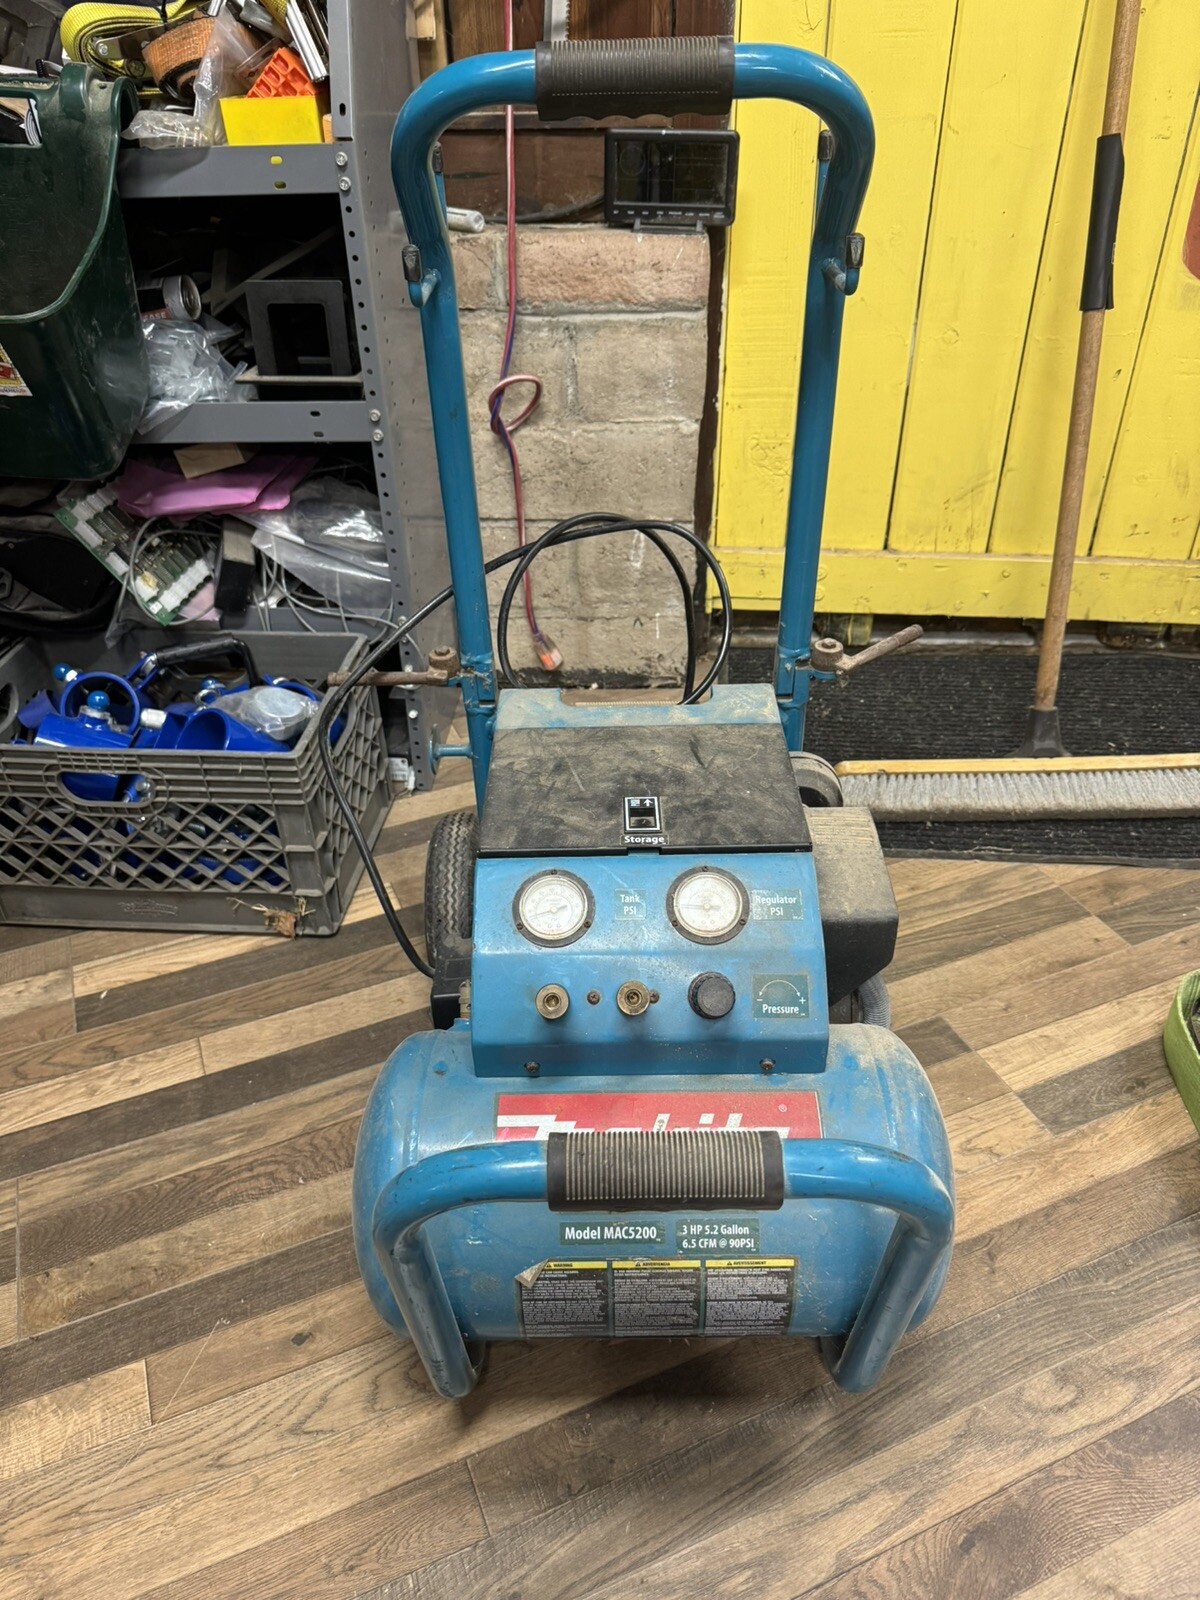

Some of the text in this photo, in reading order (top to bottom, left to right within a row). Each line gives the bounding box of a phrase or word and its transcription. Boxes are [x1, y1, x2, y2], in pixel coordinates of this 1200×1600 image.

[624, 836, 665, 845] Storage
[620, 894, 640, 903] Tank
[755, 895, 797, 906] Regulator
[623, 905, 637, 915] PSI
[770, 907, 784, 916] PSI
[762, 1003, 799, 1014] Pressure
[565, 1226, 657, 1240] Model MAC5200
[682, 1224, 750, 1235] 3 HP 5.2 Gallon
[682, 1238, 755, 1249] 6.5 CFM @ 90PSI
